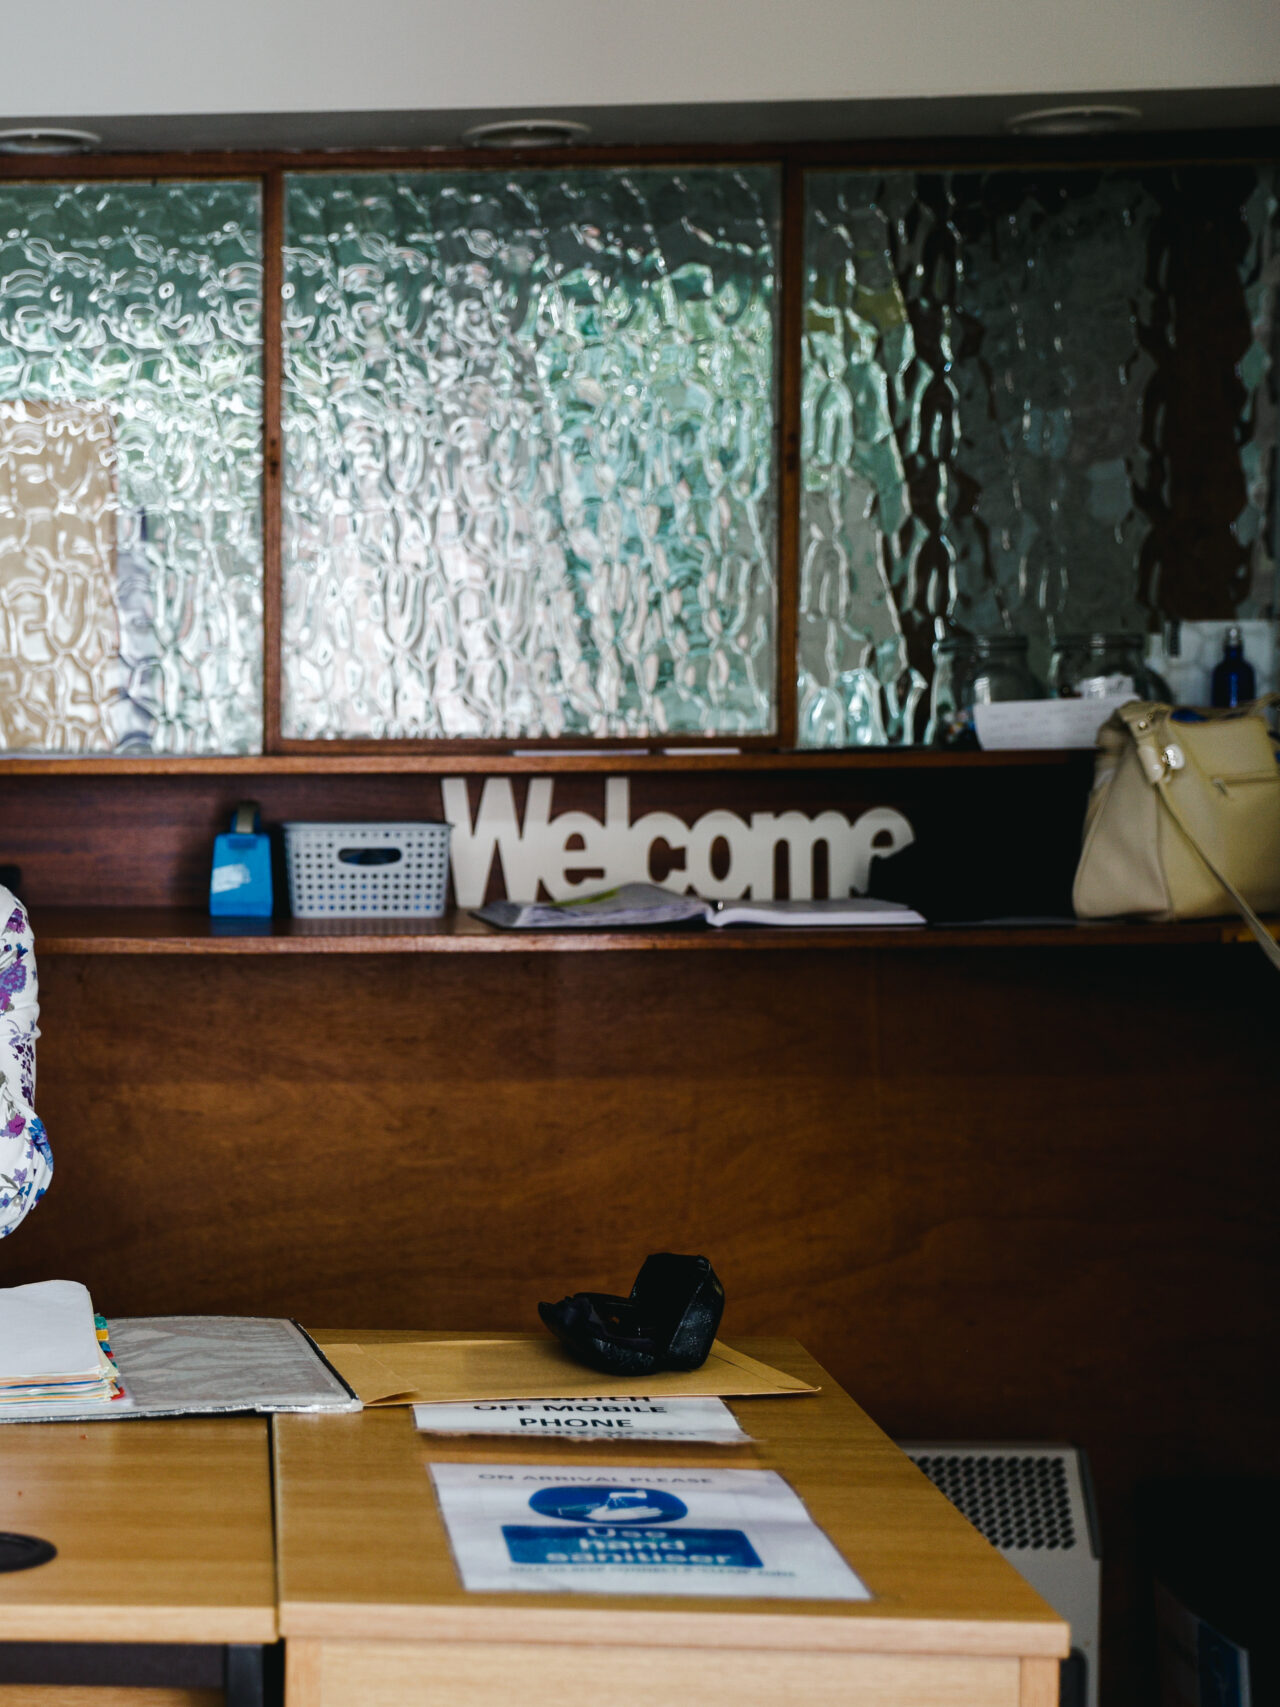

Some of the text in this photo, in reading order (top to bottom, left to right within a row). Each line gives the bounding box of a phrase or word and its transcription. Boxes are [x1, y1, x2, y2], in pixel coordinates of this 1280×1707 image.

[441, 777, 916, 909] Welcome
[543, 1405, 668, 1414] MOBILE
[519, 1418, 633, 1428] PHONE
[522, 1475, 618, 1483] ARRIVAL
[587, 1528, 668, 1539] Use
[579, 1538, 686, 1551] hand
[545, 1551, 733, 1565] sanitiser
